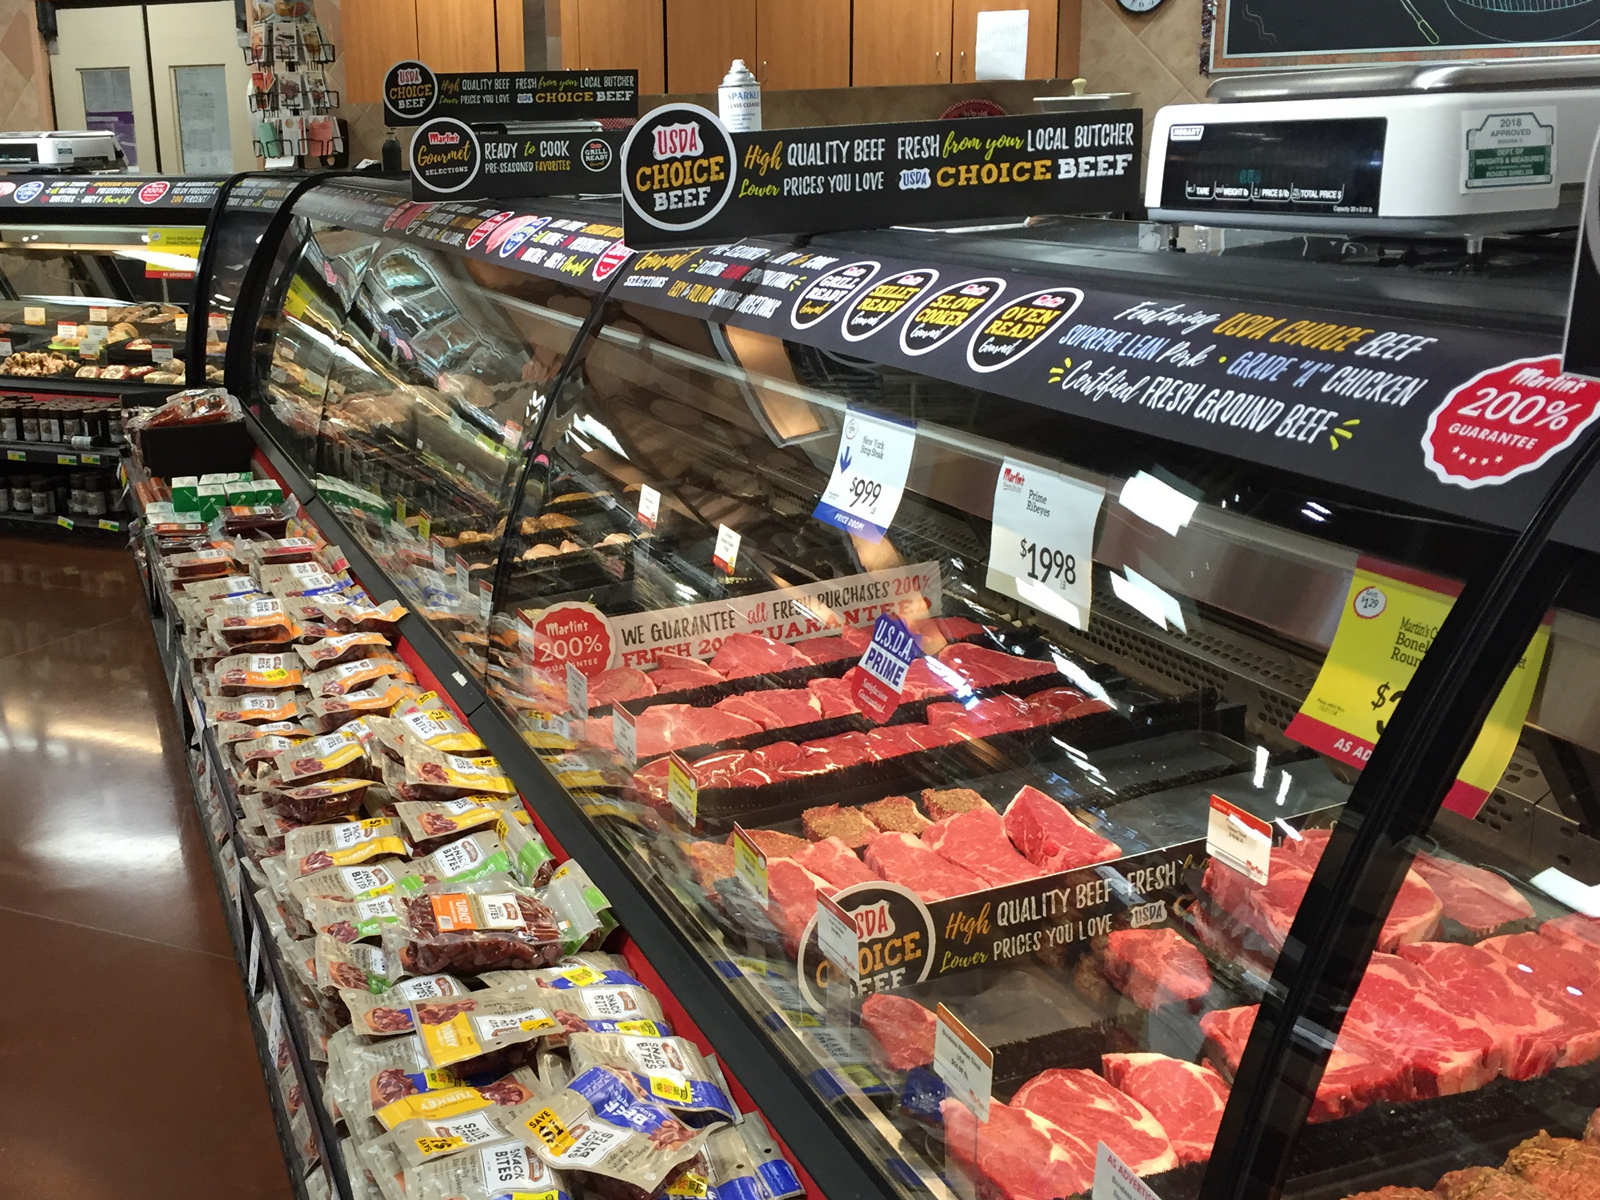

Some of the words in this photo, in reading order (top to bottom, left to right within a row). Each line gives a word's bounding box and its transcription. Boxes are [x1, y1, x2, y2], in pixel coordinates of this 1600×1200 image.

[399, 68, 420, 84] USDA
[441, 79, 460, 92] High
[461, 79, 492, 91] QUALITY
[494, 78, 511, 90] BEEF
[515, 77, 537, 89] FRESH
[538, 77, 558, 90] from
[579, 76, 602, 88] LOCAL
[603, 75, 635, 87] BUTCHER
[389, 84, 433, 99] CHOICE
[460, 94, 481, 104] PRICES
[482, 94, 495, 104] YOU
[495, 93, 511, 104] LOVE
[535, 92, 594, 103] CHOICE
[596, 90, 635, 103] BEEF
[398, 98, 426, 109] BEEF
[1173, 128, 1201, 136] HOBART
[1500, 118, 1522, 127] 2018
[657, 126, 698, 155] USDA
[1491, 128, 1531, 137] APPROVED
[417, 140, 471, 167] Gourmet
[484, 142, 518, 160] READY
[523, 141, 537, 157] to
[539, 140, 570, 157] COOK
[585, 148, 608, 156] GRILL
[744, 141, 783, 177] High
[787, 141, 850, 167] QUALITY
[854, 138, 886, 162] BEEF
[897, 134, 940, 160] FRESH
[943, 130, 983, 158] from
[985, 135, 1024, 161] your
[1027, 127, 1070, 152] LOCAL
[1074, 123, 1134, 148] BUTCHER
[425, 166, 469, 176] SELECTIONS
[485, 162, 534, 174] PRE-SEASONED
[535, 160, 571, 172] FAVORITES
[636, 155, 725, 191] CHOICE
[739, 179, 780, 198] Lower
[783, 175, 824, 196] PRICES
[827, 173, 851, 192] YOU
[855, 172, 885, 192] LOVE
[903, 171, 928, 187] USDA
[936, 159, 1052, 188] CHOICE
[1057, 153, 1133, 179] BEEF
[654, 187, 711, 212] BEEF
[1196, 187, 1210, 195] TARE
[1224, 187, 1243, 196] WEIGHT
[1261, 189, 1278, 197] PRICE
[1300, 189, 1318, 198] TOTAL
[1319, 190, 1336, 198] PRICE
[623, 275, 669, 287] SELECTIONS
[820, 277, 856, 289] GRILL
[806, 287, 849, 301] READY
[869, 284, 920, 300] SKILLET
[857, 297, 905, 313] READY
[929, 295, 985, 311] SLOW
[915, 308, 969, 327] COOKER
[1001, 306, 1062, 324] OVEN
[984, 320, 1046, 340] READY
[1113, 301, 1221, 334] Featuring
[1212, 312, 1287, 339] USDA
[1269, 319, 1375, 352] CHOICE
[1355, 331, 1438, 361] BEEF
[1059, 324, 1127, 357] SUPREME
[1119, 333, 1171, 362] LEAN
[1156, 340, 1217, 368] Pork
[1226, 351, 1299, 382] GRADE
[1293, 362, 1336, 388] "A"
[1321, 366, 1429, 407] CHICKEN
[1509, 367, 1588, 394] Martin's
[1061, 359, 1149, 403] Certified
[1139, 379, 1202, 419] FRESH
[1193, 390, 1285, 432] GROUND
[1274, 404, 1339, 444] BEEF
[1457, 387, 1583, 430] 200%
[862, 435, 873, 447] New
[874, 437, 885, 450] York
[1448, 422, 1539, 450] GUARANTEE
[1003, 467, 1025, 486] Martin's
[1028, 489, 1048, 505] Prime
[834, 512, 849, 525] PRICE
[1026, 501, 1050, 518] Ribeyes
[1060, 580, 1066, 590] LB
[621, 629, 646, 646] WE
[651, 610, 736, 642] GUARANTEE
[747, 602, 768, 625] all
[773, 596, 814, 620] FRESH
[817, 580, 890, 611] PURCHASES
[545, 620, 588, 637] Martin's
[1400, 616, 1430, 638] Martin's
[538, 634, 603, 663] 200%
[874, 619, 912, 662] U.S.D.A.
[621, 642, 691, 668] FRESH
[865, 647, 904, 687] PRIME
[1333, 738, 1353, 753] AS
[442, 847, 461, 871] BITES
[945, 902, 991, 945] High
[996, 887, 1072, 927] QUALITY
[1076, 878, 1113, 909] BEEF
[1127, 861, 1176, 897] FRESH
[854, 905, 888, 940] SDA
[940, 949, 988, 974] Lower
[993, 933, 1042, 961] PRICES
[1045, 926, 1074, 947] YOU
[1078, 915, 1114, 940] LOVE
[1134, 904, 1163, 924] USDA
[593, 995, 611, 1016] BITES
[604, 994, 622, 1015] SNACK
[637, 1042, 657, 1070] BITES
[648, 1042, 668, 1070] SNACK
[529, 1110, 551, 1128] SAVE
[495, 1151, 513, 1182] BITES
[509, 1149, 525, 1180] SNACK
[1107, 1155, 1117, 1169] AS
